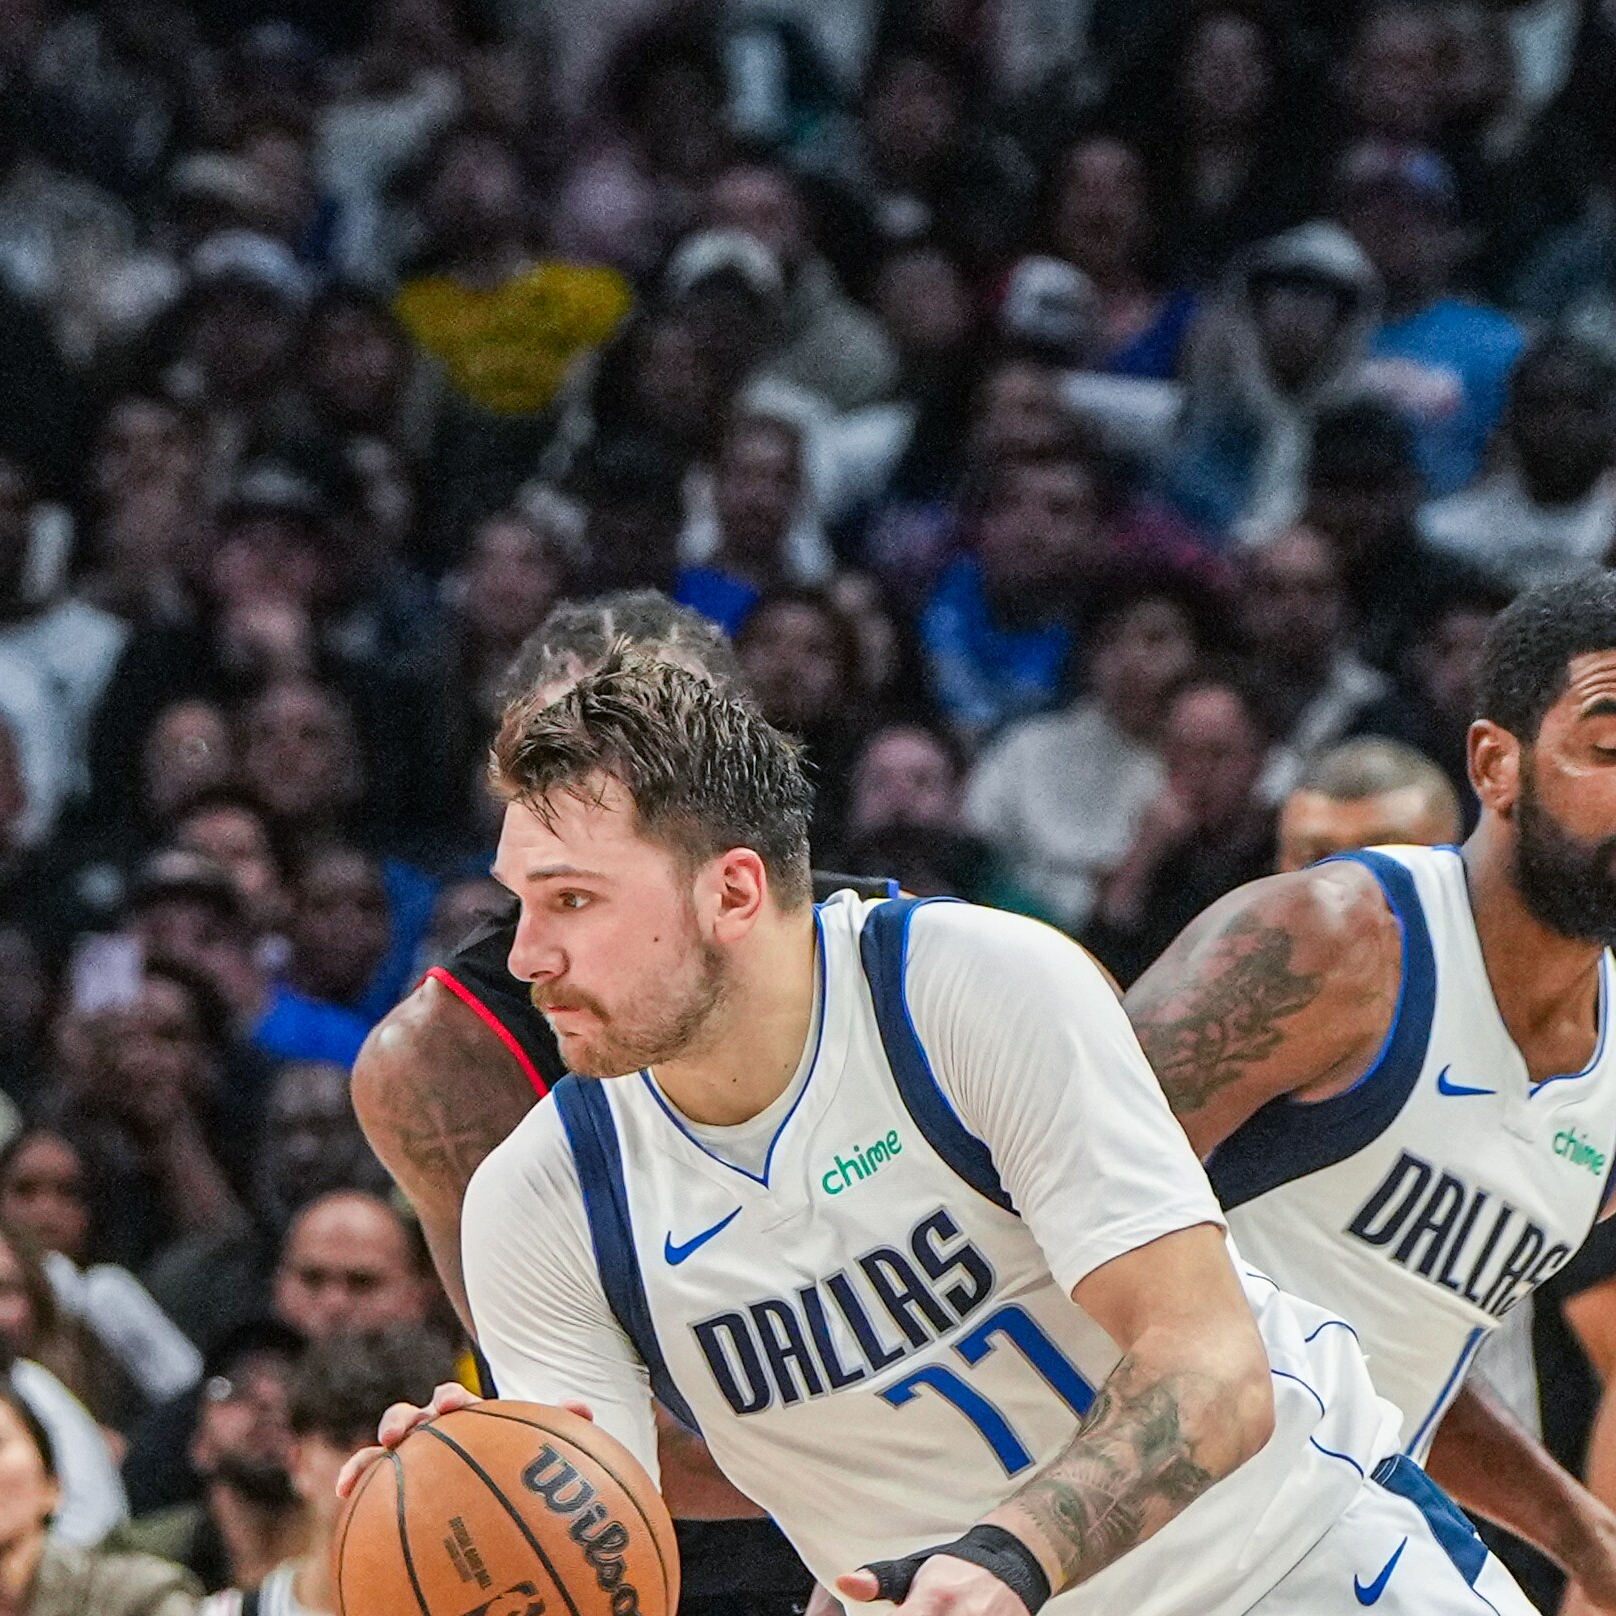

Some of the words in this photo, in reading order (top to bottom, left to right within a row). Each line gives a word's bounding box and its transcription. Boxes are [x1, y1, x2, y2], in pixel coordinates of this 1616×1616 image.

[821, 1129, 903, 1195] chime
[1551, 1127, 1607, 1176] chime
[686, 1205, 997, 1417] DALLAS
[876, 1303, 1097, 1479] 77
